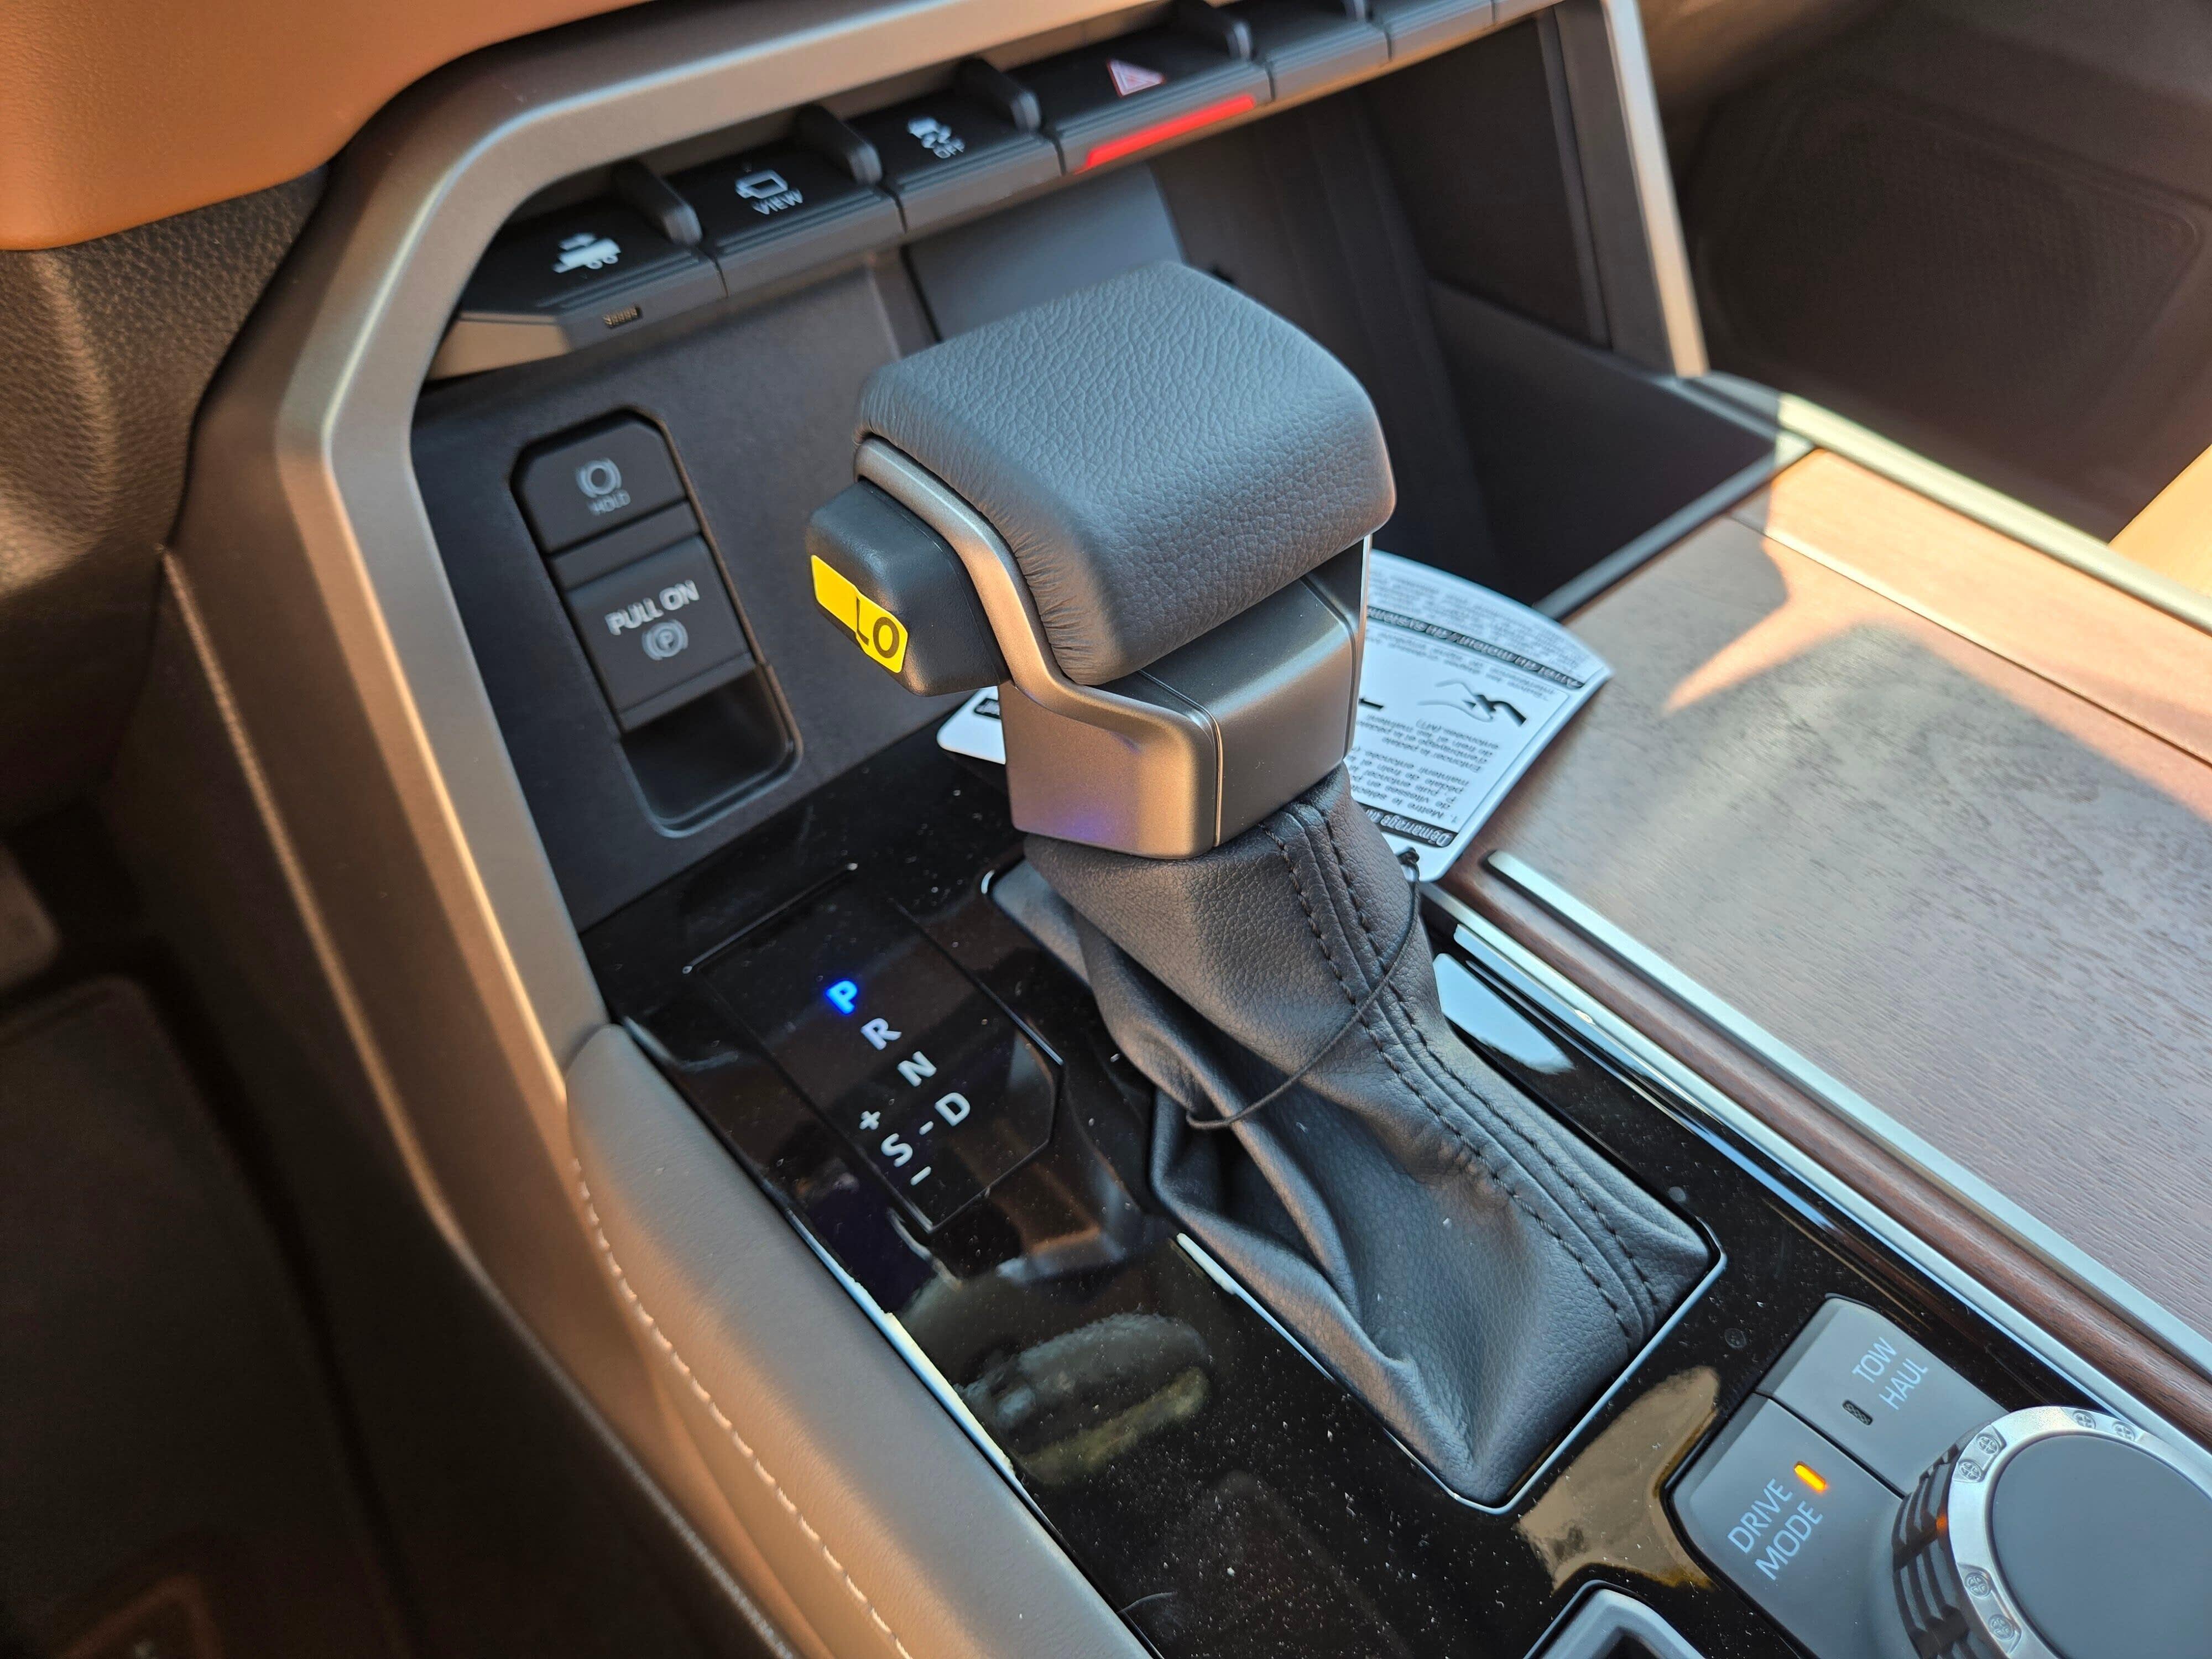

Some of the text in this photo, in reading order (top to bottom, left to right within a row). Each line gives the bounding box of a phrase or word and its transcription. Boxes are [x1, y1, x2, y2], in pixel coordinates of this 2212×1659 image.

[752, 188, 803, 215] VIEW
[588, 489, 630, 515] HOLD
[604, 580, 700, 635] PULL ON
[856, 596, 900, 659] LO
[1391, 797, 1403, 806] le
[1407, 802, 1444, 819] Mettre
[1434, 801, 1451, 809] de
[1380, 815, 1453, 847] Démarrage
[827, 980, 858, 1015] P
[860, 1018, 902, 1050] R
[897, 1051, 937, 1087] N
[935, 1092, 971, 1126] D
[881, 1133, 913, 1167] S
[1852, 1336, 1897, 1383] TOW
[1879, 1358, 1929, 1410] HAUL
[1727, 1478, 1793, 1553] DRIVE
[1755, 1500, 1823, 1580] MODE
